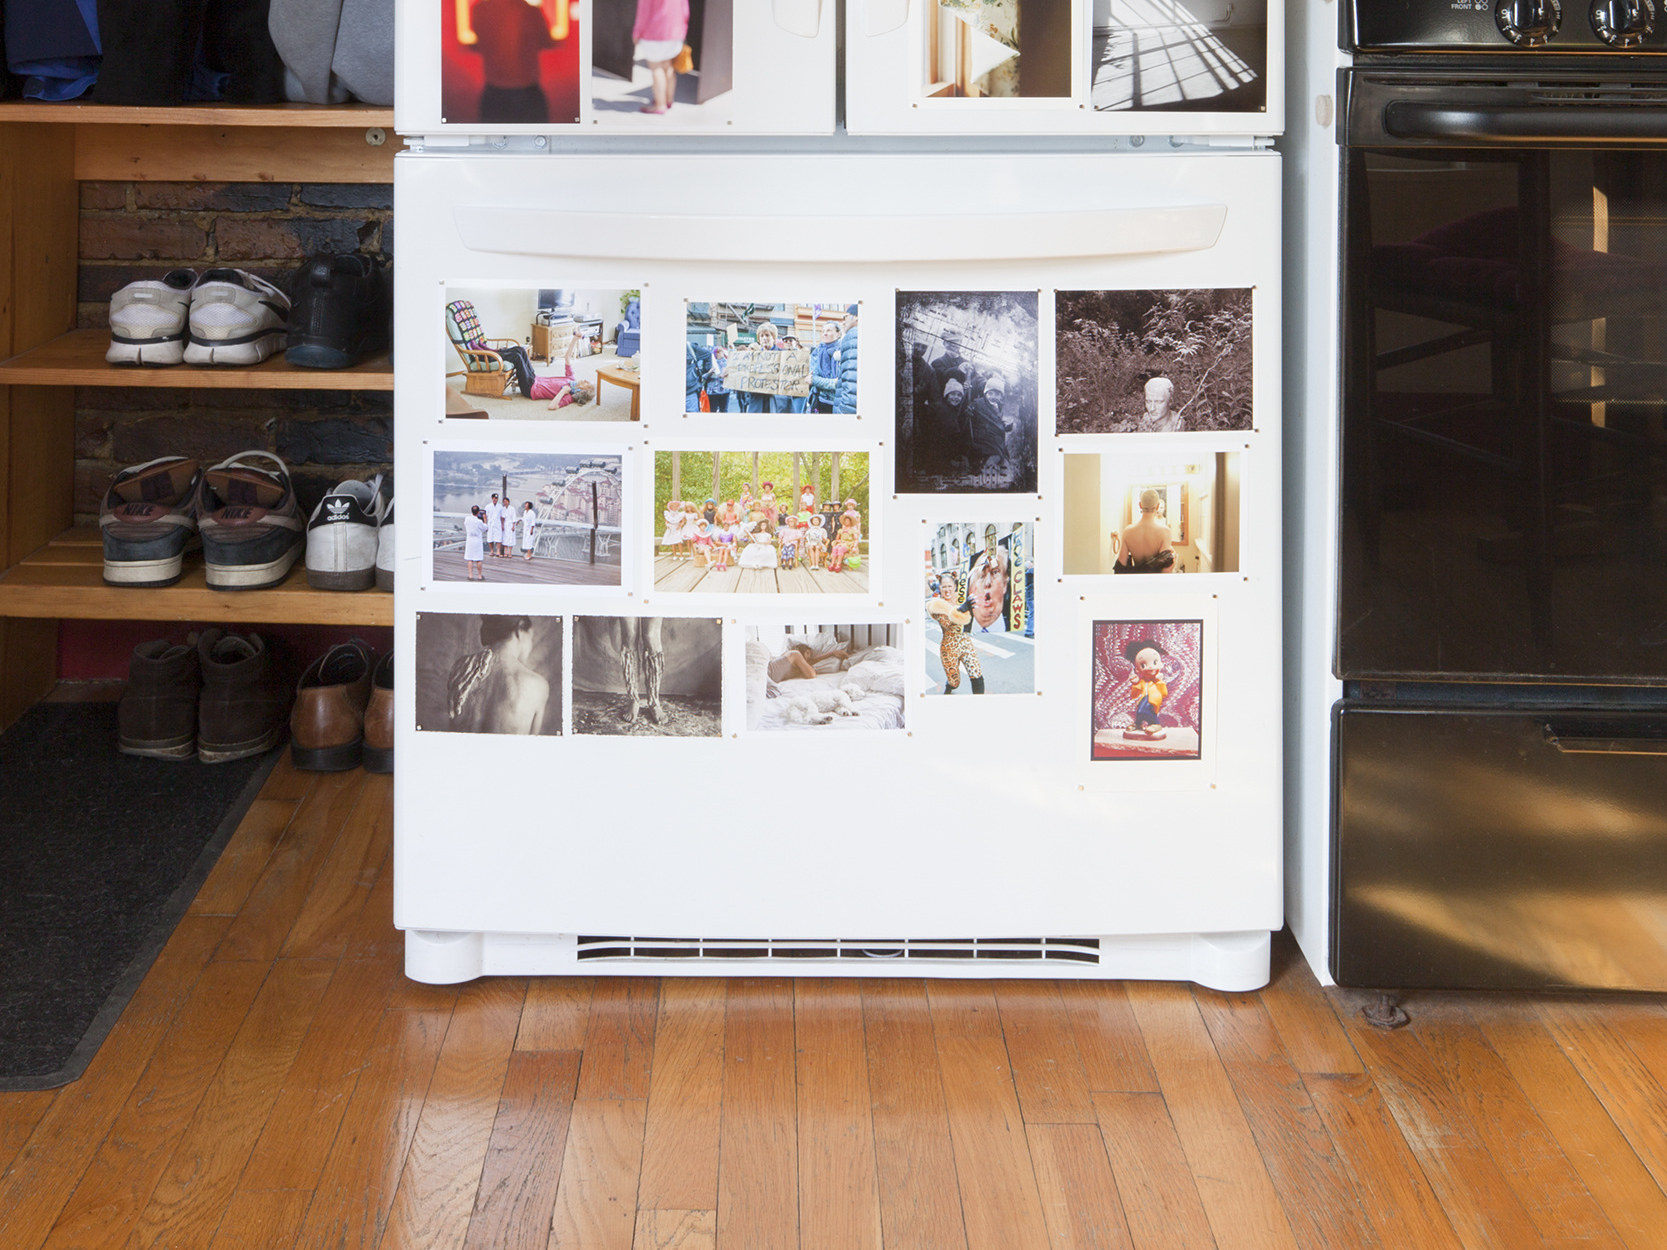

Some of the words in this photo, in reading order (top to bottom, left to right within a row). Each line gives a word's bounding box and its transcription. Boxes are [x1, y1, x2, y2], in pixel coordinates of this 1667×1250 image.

[757, 351, 779, 361] NOT
[786, 352, 798, 361] A
[737, 362, 809, 378] PROFESSONAL
[122, 503, 156, 517] NIKE
[221, 507, 254, 519] NIKE
[1013, 570, 1023, 629] CLAWS
